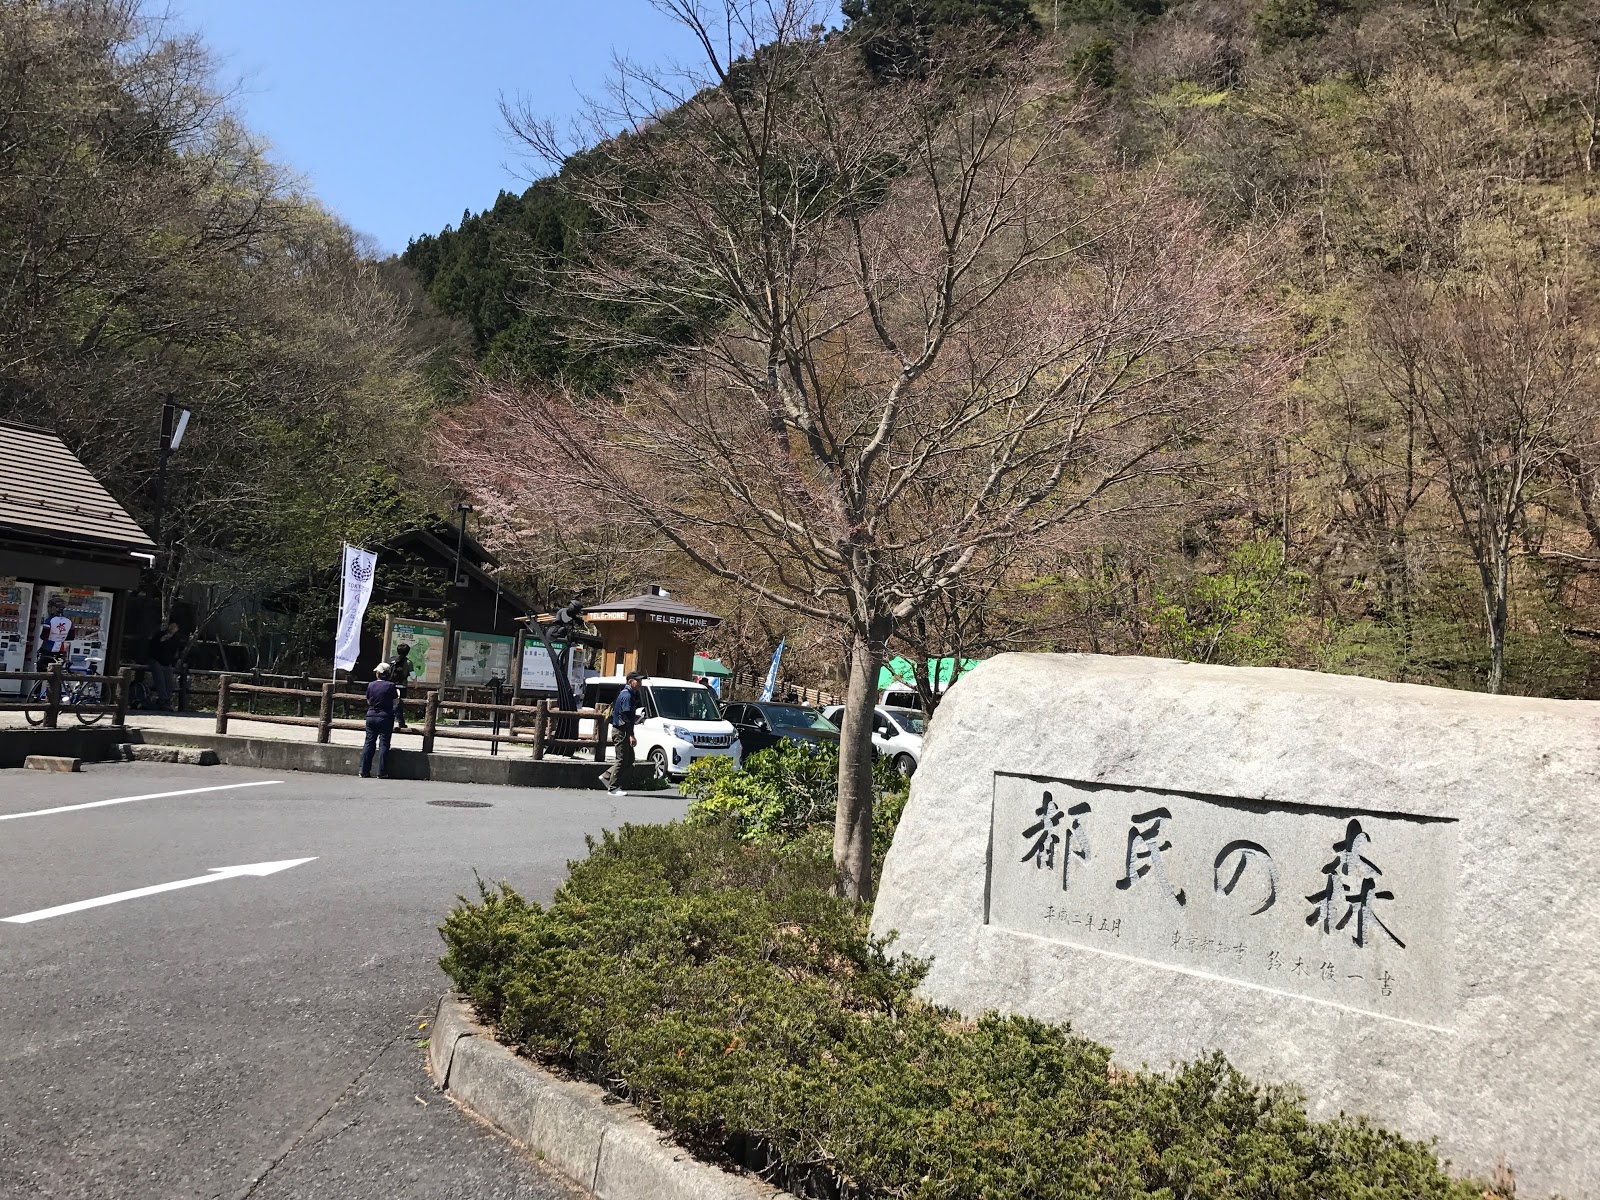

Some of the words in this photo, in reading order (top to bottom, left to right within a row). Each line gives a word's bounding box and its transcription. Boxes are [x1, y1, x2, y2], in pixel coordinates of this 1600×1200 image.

[589, 611, 625, 620] TELEPHONE
[649, 613, 708, 627] TELEPHONE
[1021, 791, 1406, 950] 都民の森
